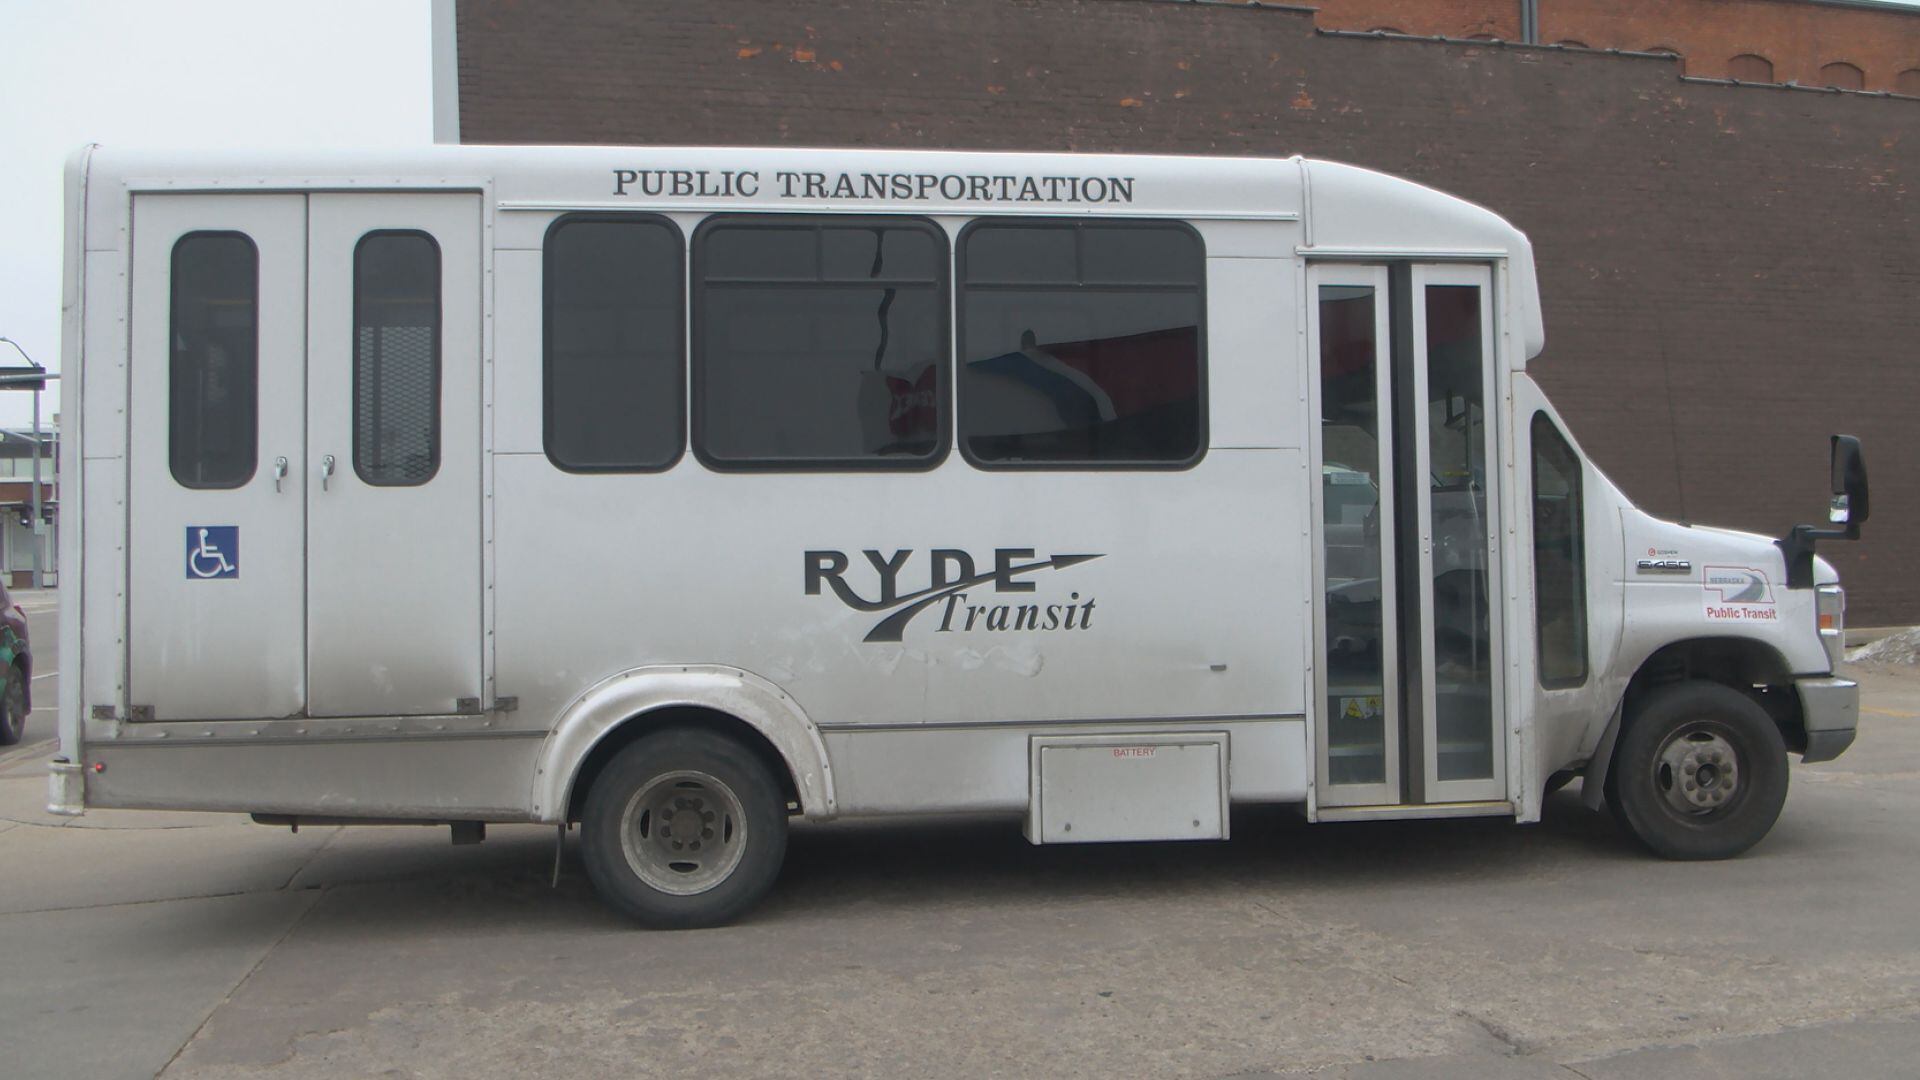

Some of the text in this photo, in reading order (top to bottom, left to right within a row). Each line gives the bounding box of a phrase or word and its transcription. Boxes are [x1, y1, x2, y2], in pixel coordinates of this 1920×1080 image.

[613, 169, 1135, 203] PUBLIC TRANSPORTATION
[804, 548, 1037, 612] RYDE
[935, 592, 1096, 633] Transit
[1706, 607, 1777, 620] Public Transit
[1113, 748, 1156, 757] BATTERY
